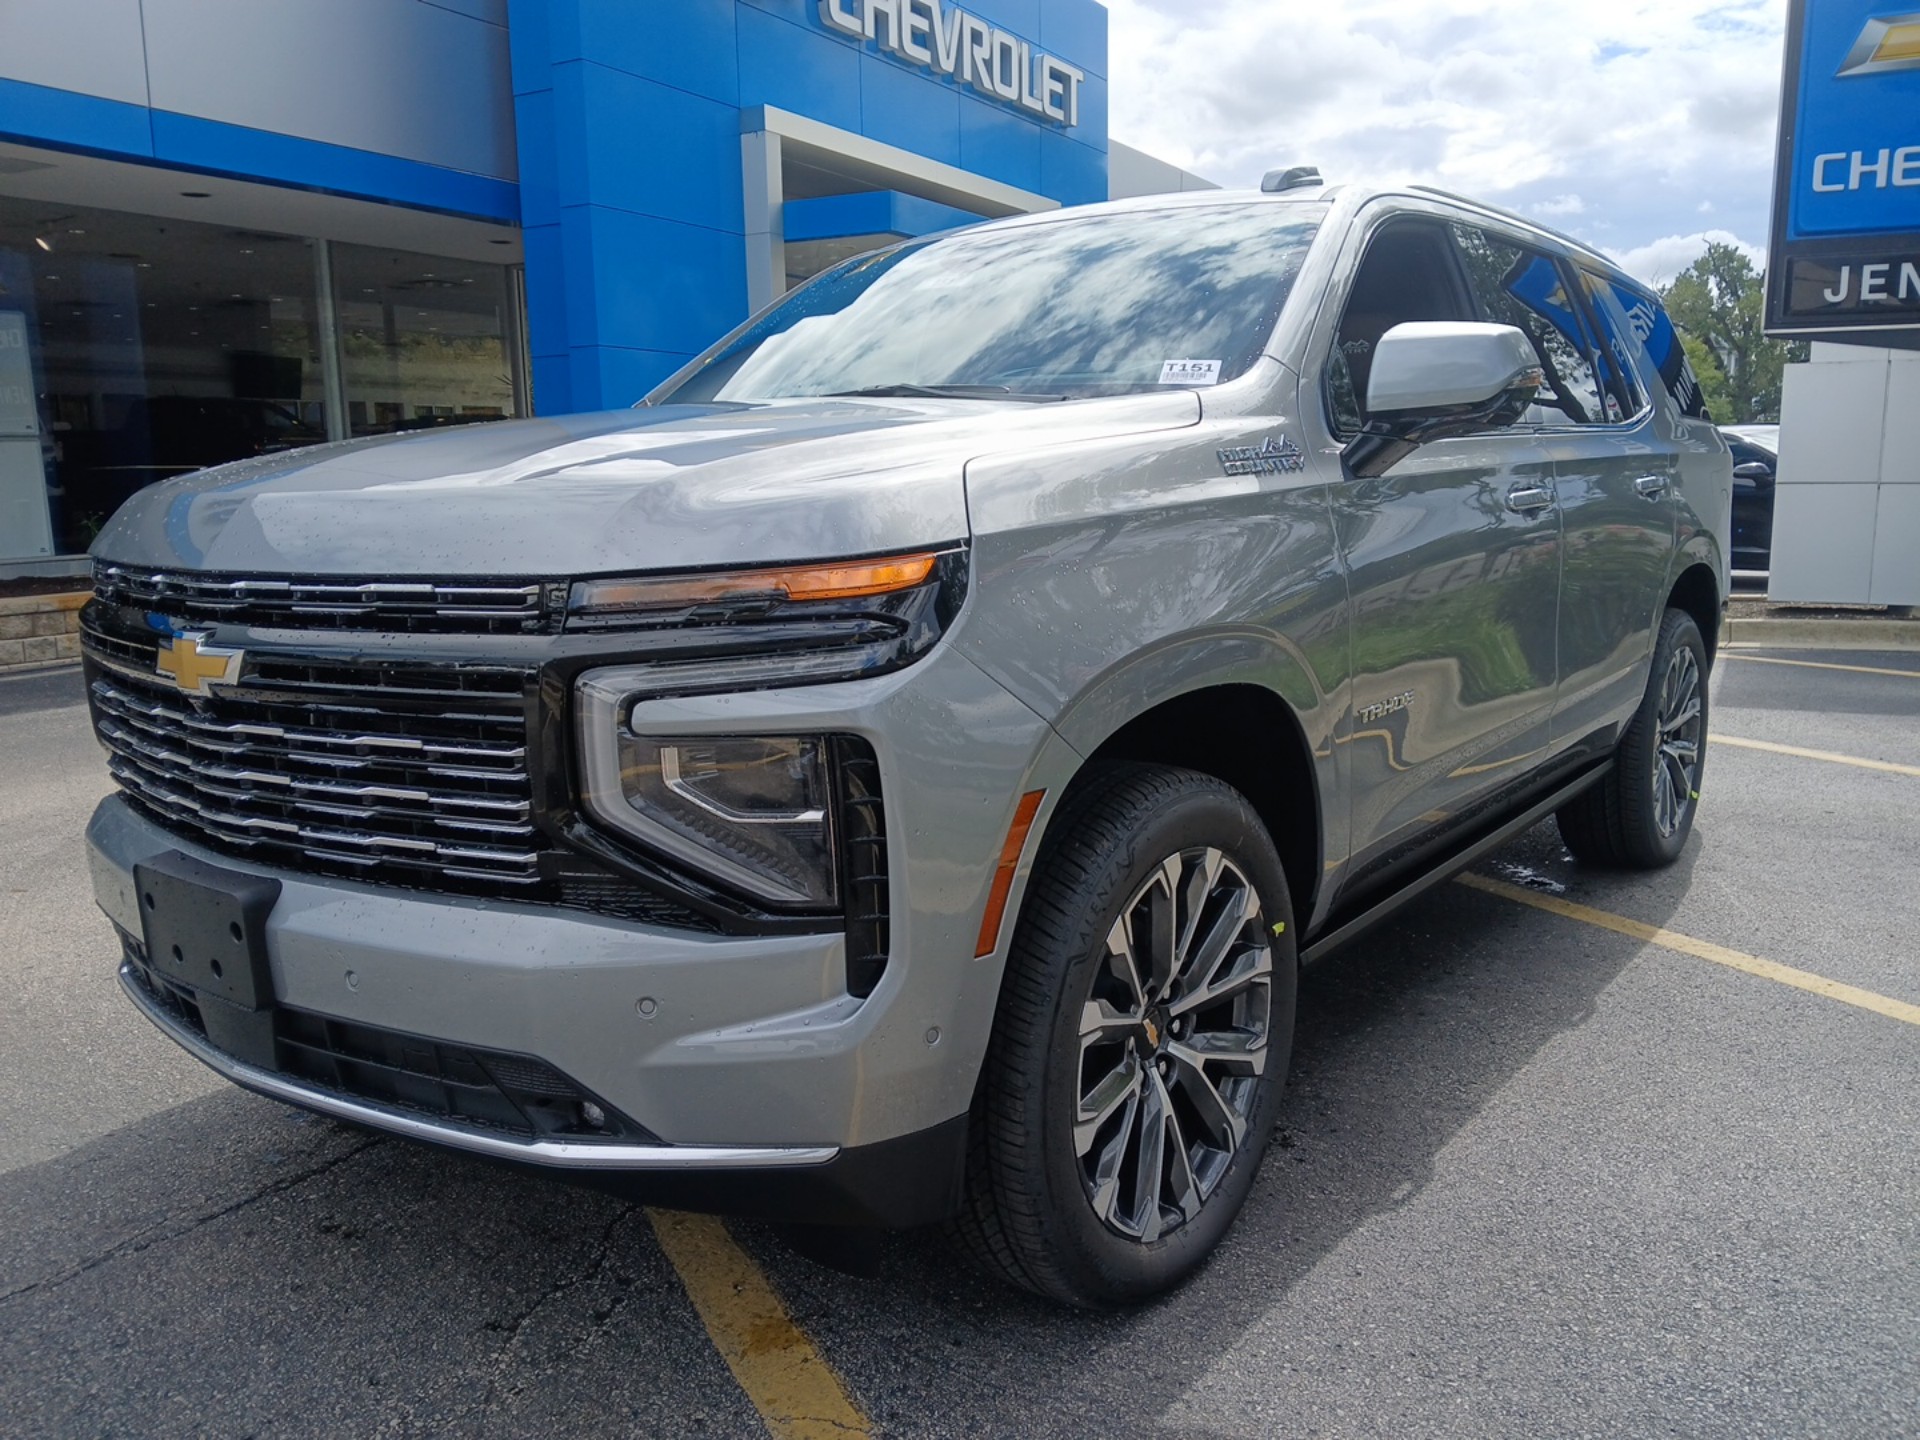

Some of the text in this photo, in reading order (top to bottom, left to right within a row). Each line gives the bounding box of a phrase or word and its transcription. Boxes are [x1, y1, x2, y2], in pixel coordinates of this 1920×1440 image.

[1812, 146, 1920, 192] CHE
[1823, 262, 1920, 303] JEN
[1166, 362, 1214, 373] T151
